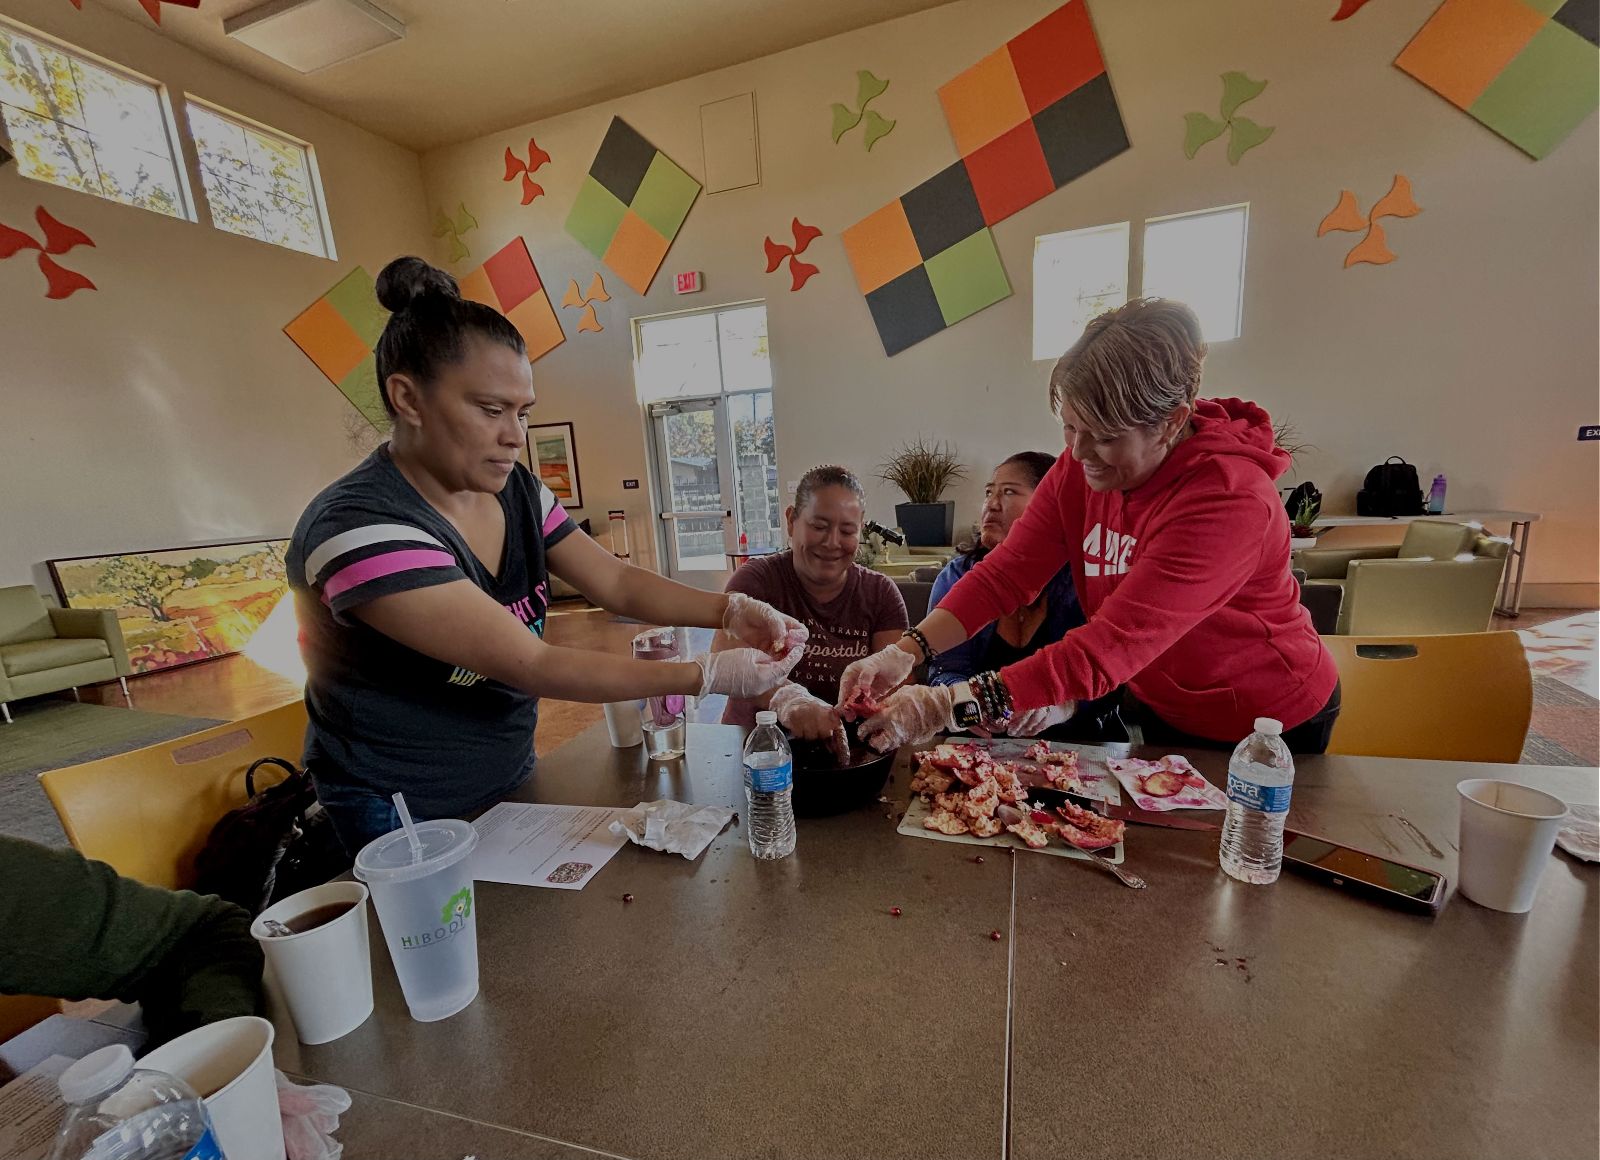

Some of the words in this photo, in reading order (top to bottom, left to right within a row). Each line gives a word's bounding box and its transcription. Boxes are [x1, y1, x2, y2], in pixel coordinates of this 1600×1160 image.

[677, 271, 697, 291] EXIT
[830, 625, 868, 637] BRAND
[803, 641, 868, 658] opostale
[1228, 776, 1260, 799] gara
[401, 913, 464, 947] HIBODY
